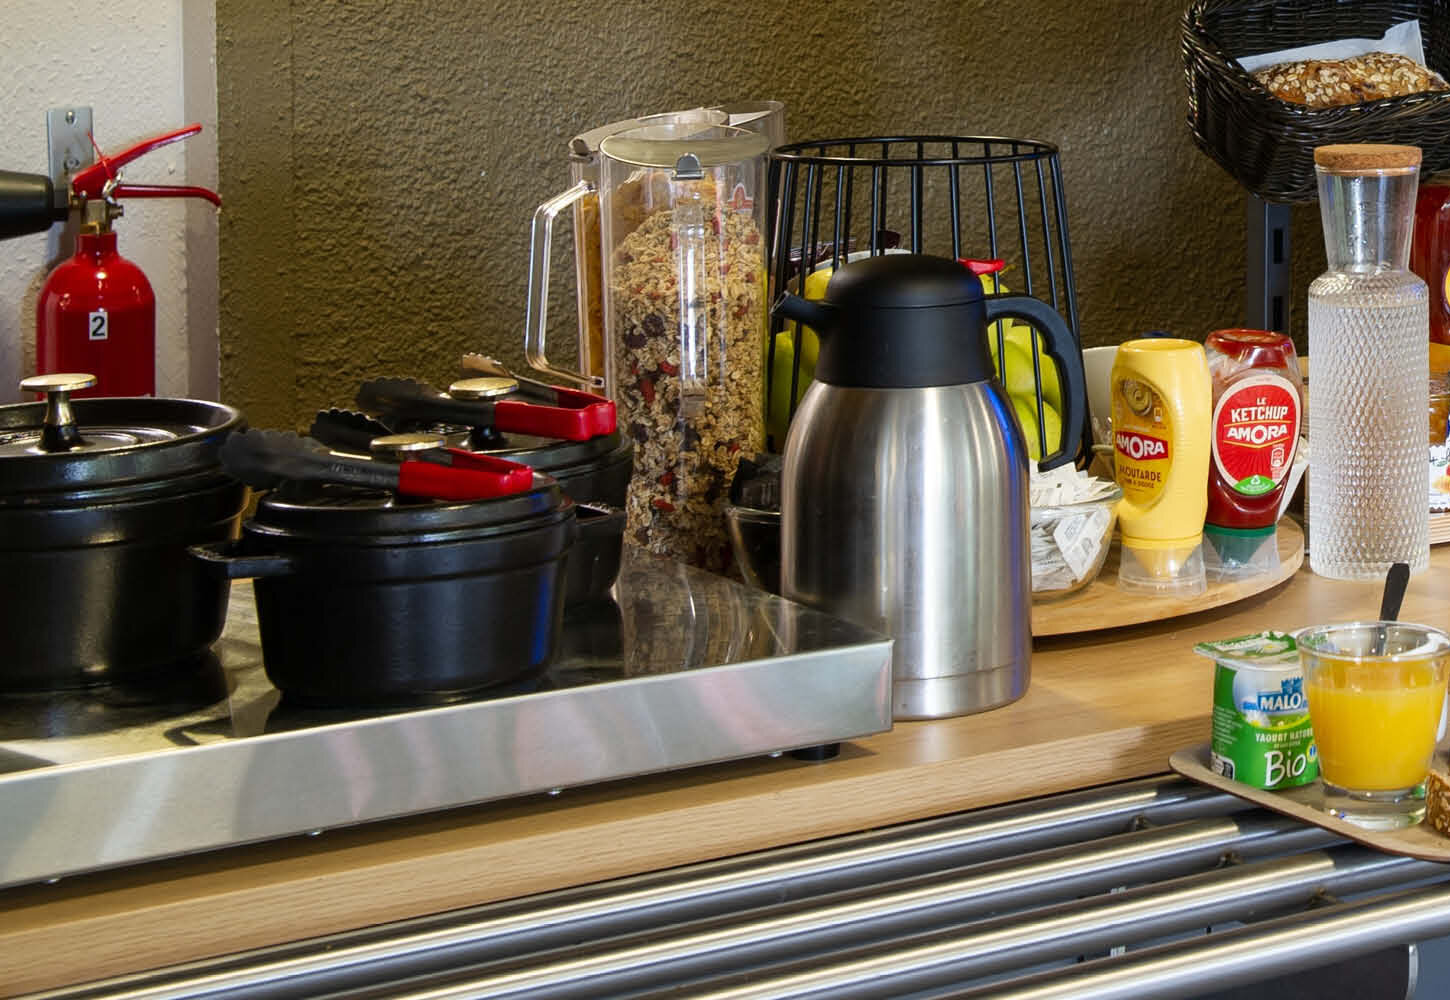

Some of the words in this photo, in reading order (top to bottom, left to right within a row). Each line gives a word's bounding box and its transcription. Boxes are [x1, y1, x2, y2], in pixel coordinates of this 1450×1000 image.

[91, 315, 106, 338] 2
[1256, 397, 1268, 406] LE
[1231, 405, 1289, 423] KETCHUP
[1226, 423, 1289, 445] AMORA
[1116, 433, 1165, 460] AMORA
[1260, 692, 1302, 712] MALO
[1255, 731, 1288, 743] YAOURT
[1264, 748, 1307, 787] Bio
